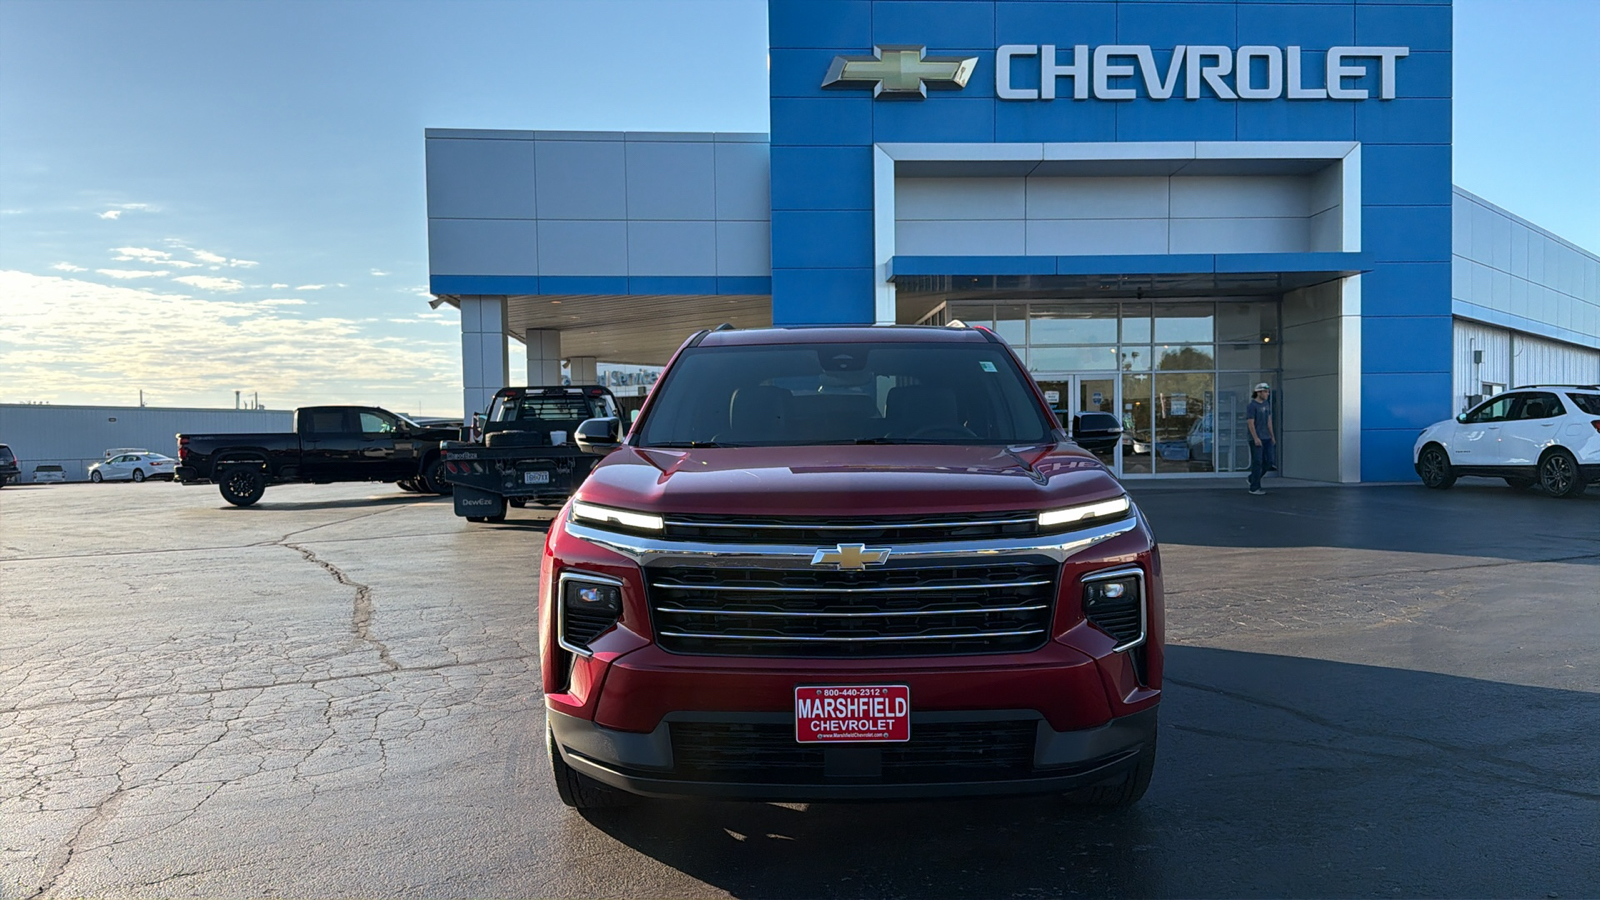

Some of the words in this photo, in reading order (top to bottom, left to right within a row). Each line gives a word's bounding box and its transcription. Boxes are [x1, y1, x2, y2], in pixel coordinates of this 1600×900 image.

[995, 44, 1410, 101] CHEVROLET
[462, 498, 493, 506] DewEze
[798, 697, 907, 719] MARSHFIELD
[810, 720, 895, 731] CHEVROLET
